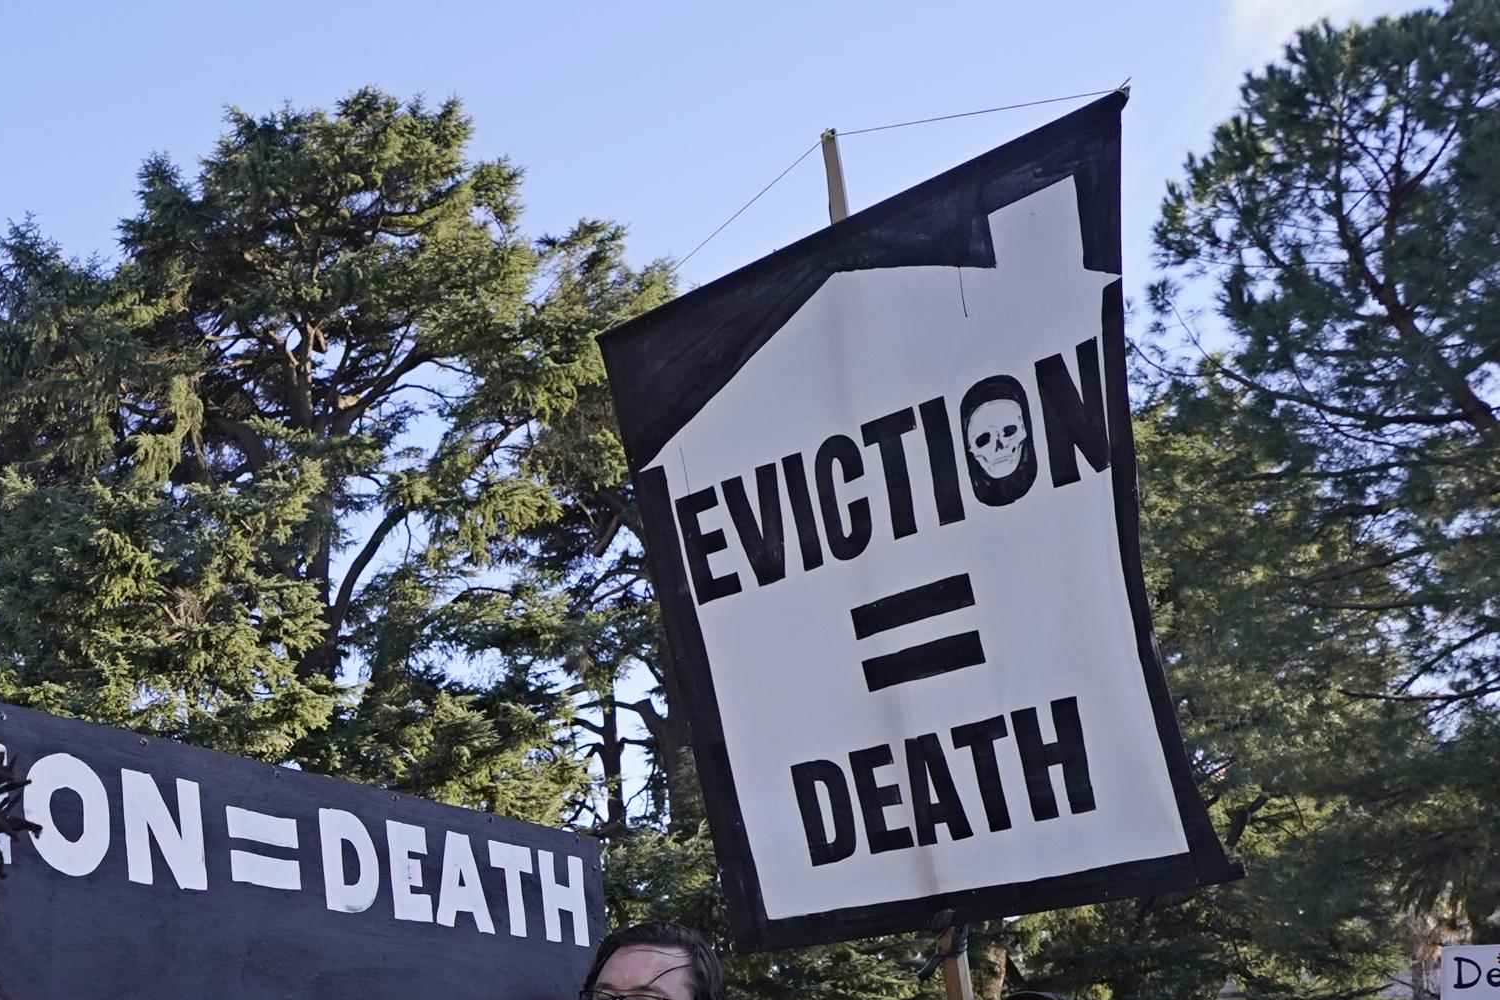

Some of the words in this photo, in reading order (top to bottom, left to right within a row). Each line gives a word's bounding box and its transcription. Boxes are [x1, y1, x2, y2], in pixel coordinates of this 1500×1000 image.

[674, 336, 1112, 605] EVICTION
[790, 696, 1097, 867] DEATH
[318, 807, 590, 948] DEATH
